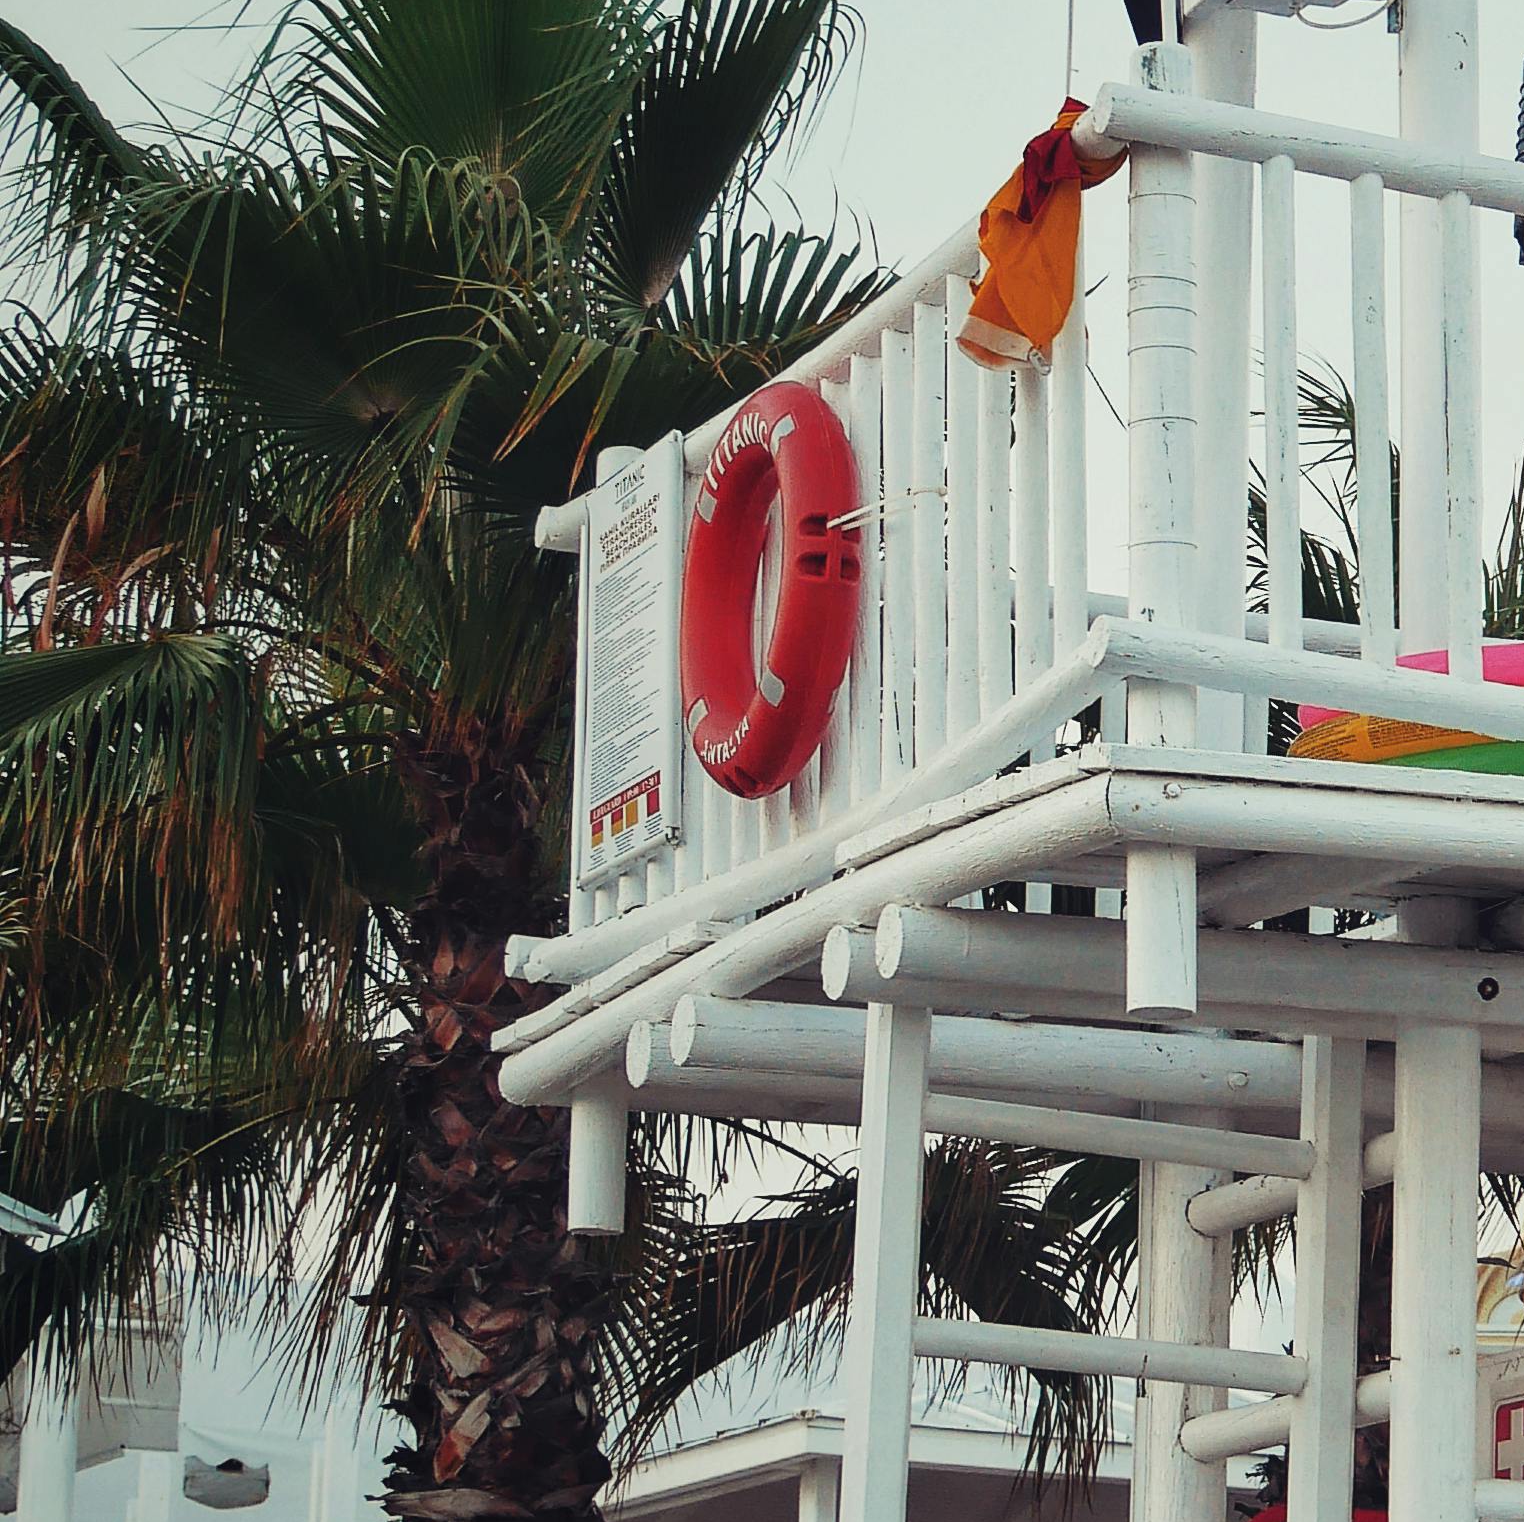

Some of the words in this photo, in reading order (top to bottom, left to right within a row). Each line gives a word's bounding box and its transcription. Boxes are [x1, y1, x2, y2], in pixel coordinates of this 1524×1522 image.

[706, 412, 769, 491] TITANIC
[614, 463, 645, 499] TITANIC
[605, 537, 629, 559] BEACH
[700, 715, 750, 766] ANTALYA
